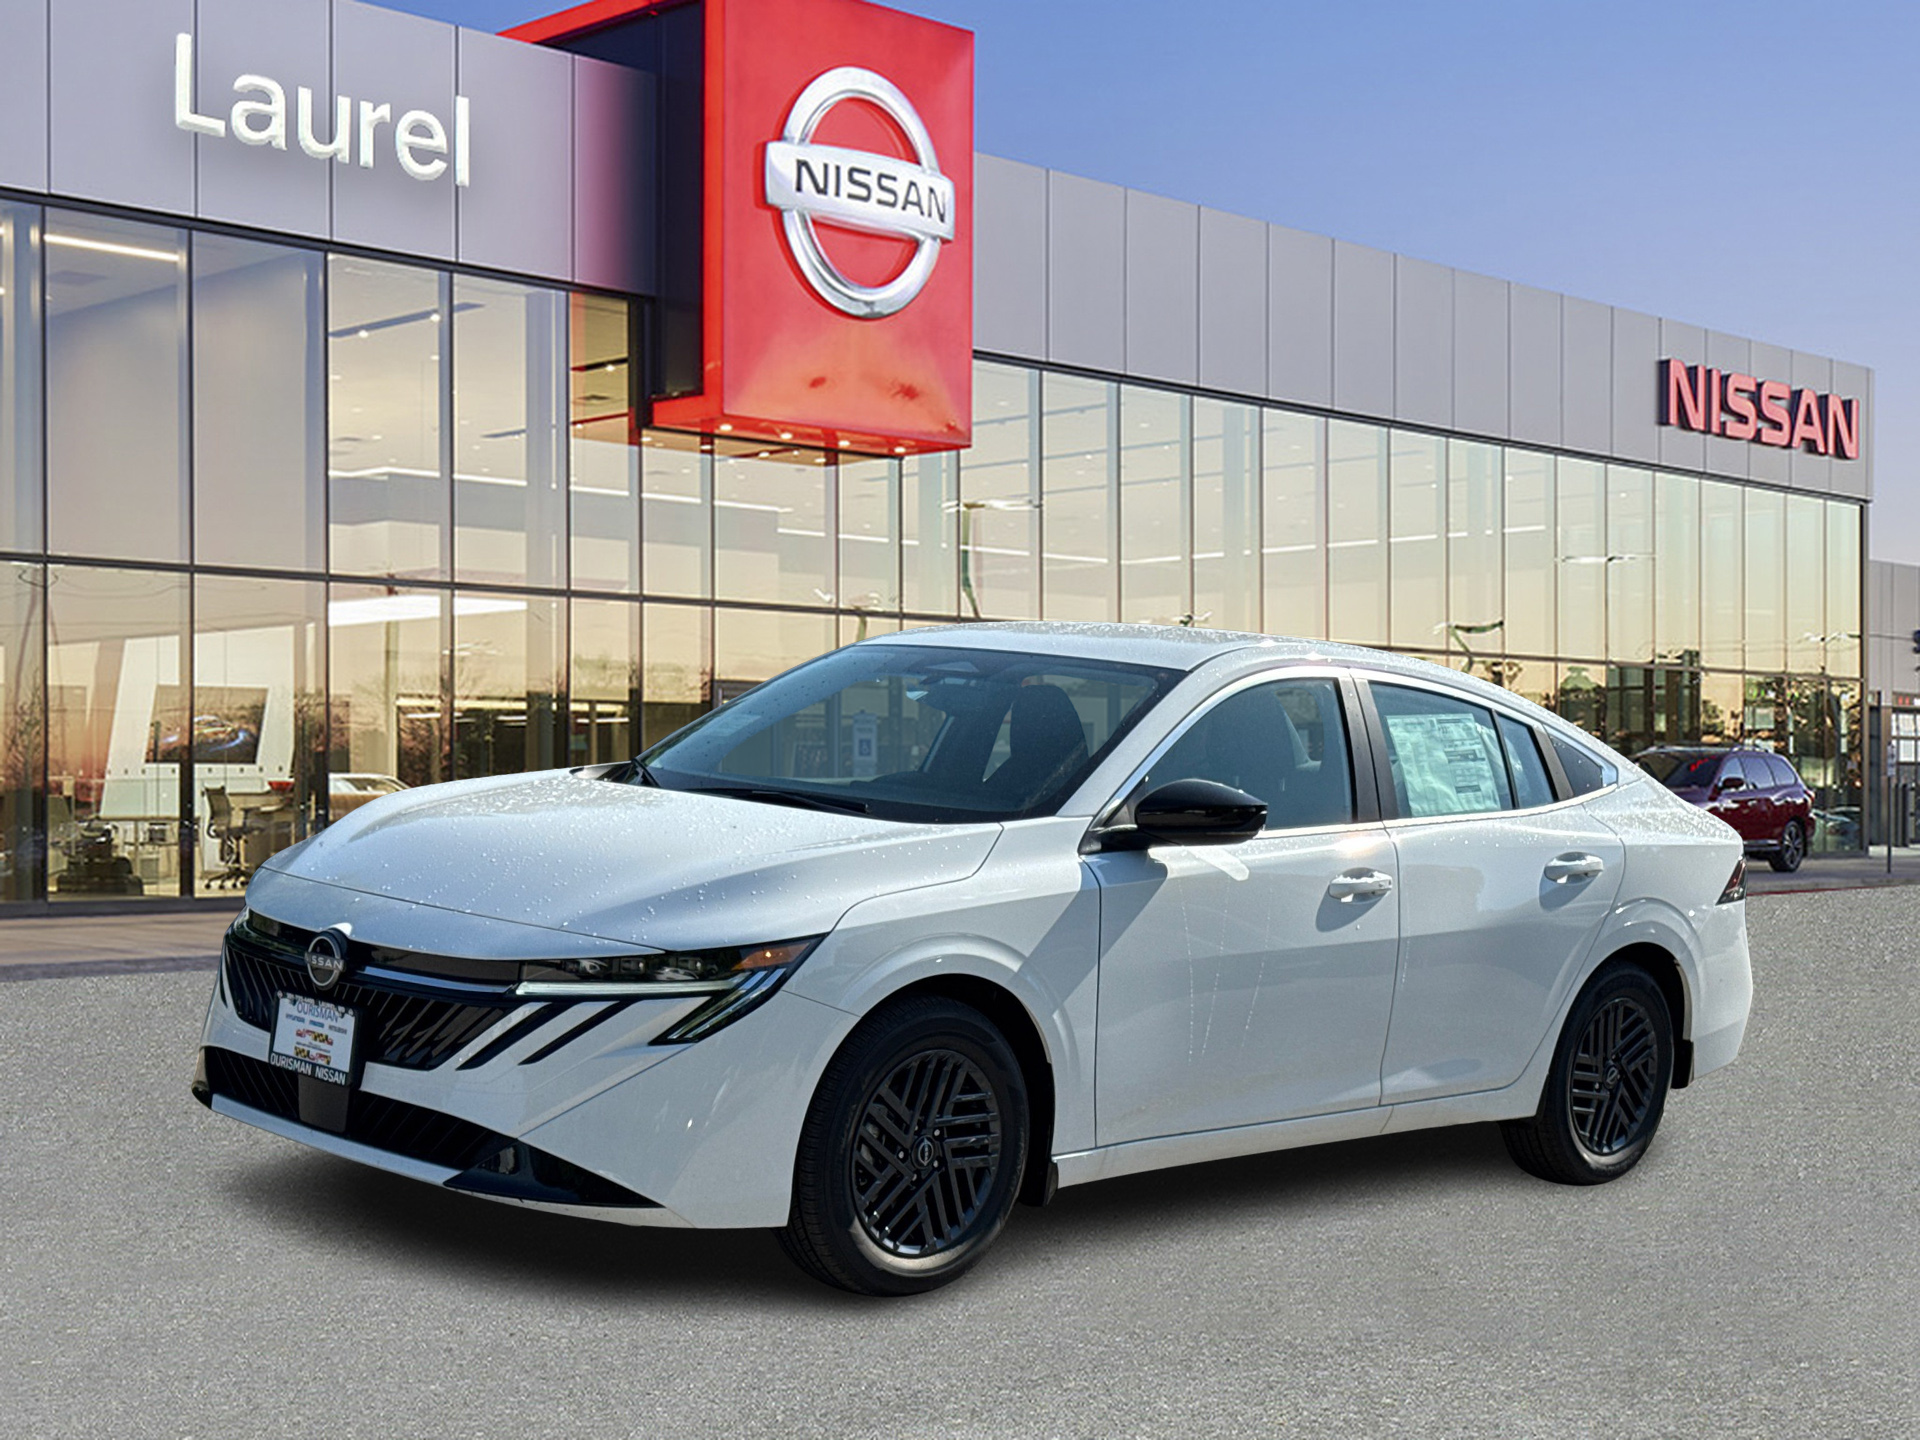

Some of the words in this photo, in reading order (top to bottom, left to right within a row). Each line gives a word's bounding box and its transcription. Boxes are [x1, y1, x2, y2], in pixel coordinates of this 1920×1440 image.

[175, 32, 470, 188] Laurel
[795, 158, 946, 223] NISSAN
[1659, 358, 1860, 459] NISSAN
[304, 952, 345, 972] SSAN
[270, 1053, 311, 1075] OURISMAN
[315, 1066, 346, 1085] NISSAN
